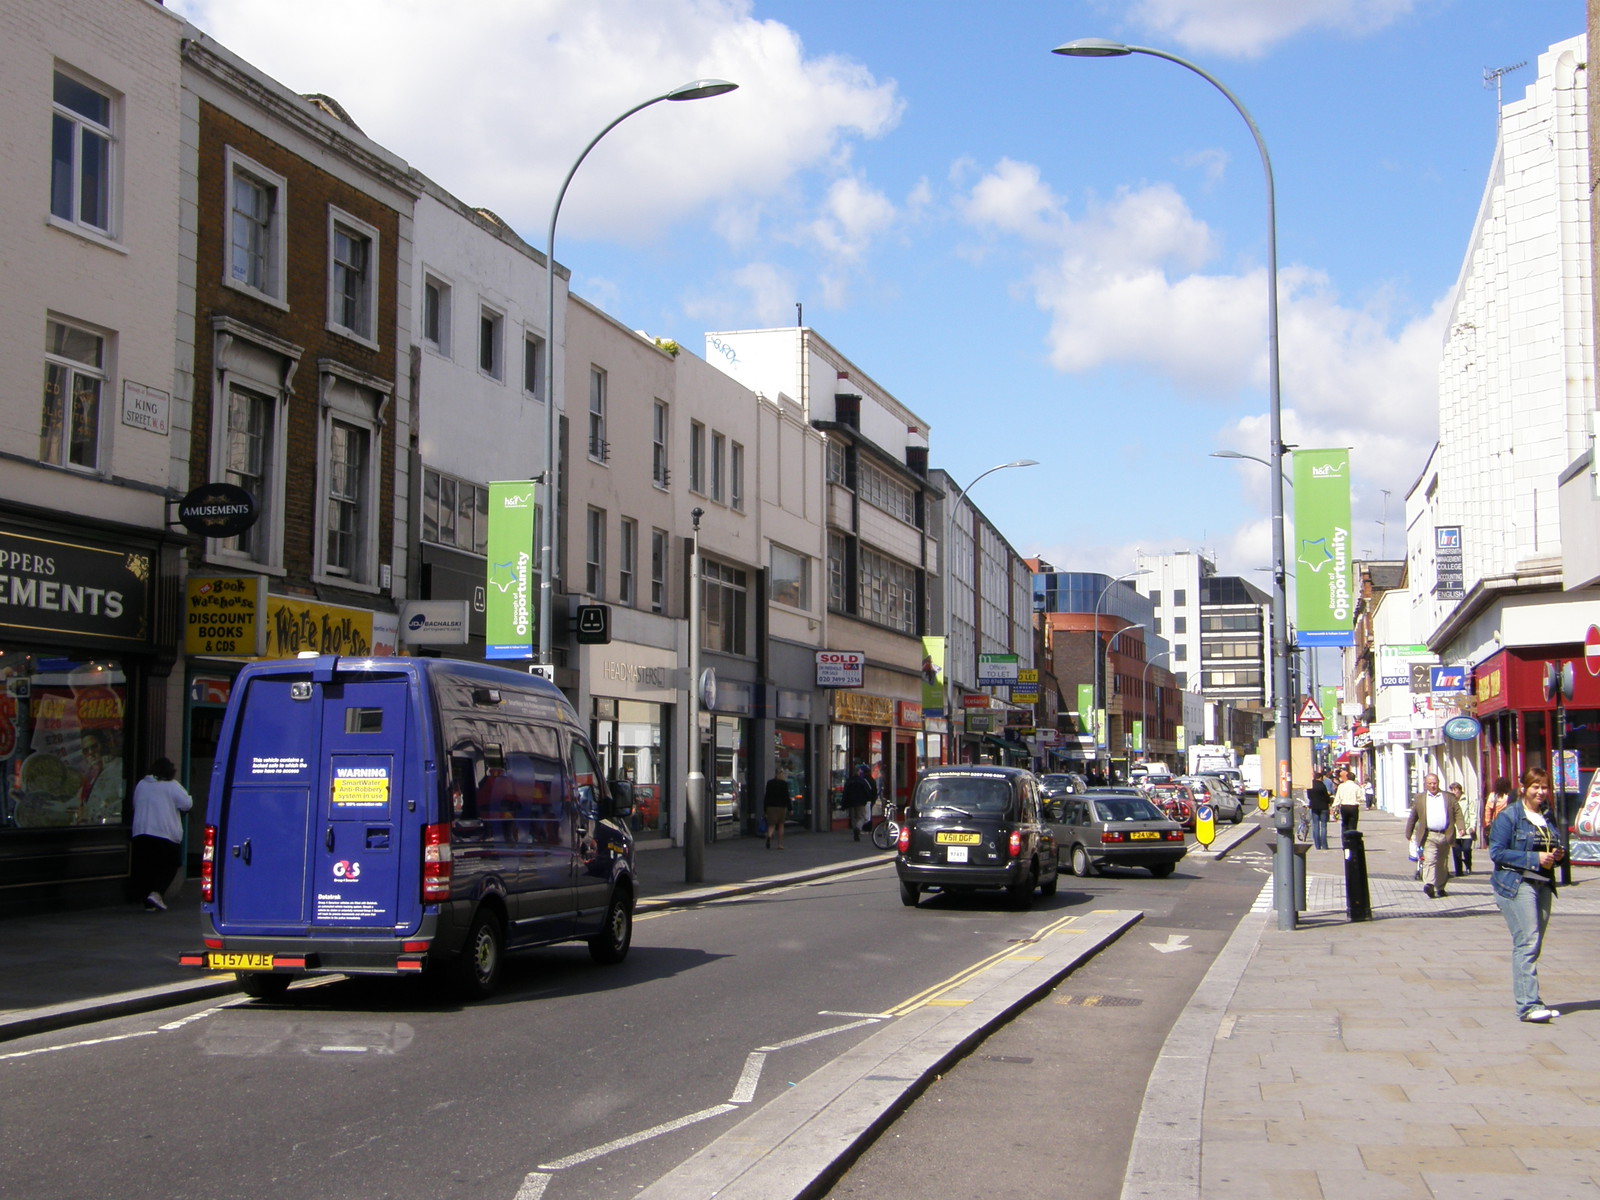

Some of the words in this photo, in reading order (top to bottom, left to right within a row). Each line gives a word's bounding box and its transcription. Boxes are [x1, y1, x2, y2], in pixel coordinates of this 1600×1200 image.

[135, 399, 157, 414] KING
[183, 504, 249, 516] AMUSEMENTS
[1332, 527, 1348, 620] Opportunity
[213, 579, 246, 593] Book
[517, 552, 529, 635] Opportunity
[191, 596, 254, 609] Warehouse
[189, 613, 254, 624] DISCOUNT
[198, 627, 243, 638] BOOKS
[205, 641, 212, 651] &
[216, 641, 235, 652] CDS
[820, 654, 858, 663] SOLD
[603, 661, 657, 685] HEADMASTERS
[1435, 671, 1462, 686] hmc
[337, 768, 386, 778] WARNING
[213, 954, 243, 966] LT57
[248, 954, 270, 966] VJE
